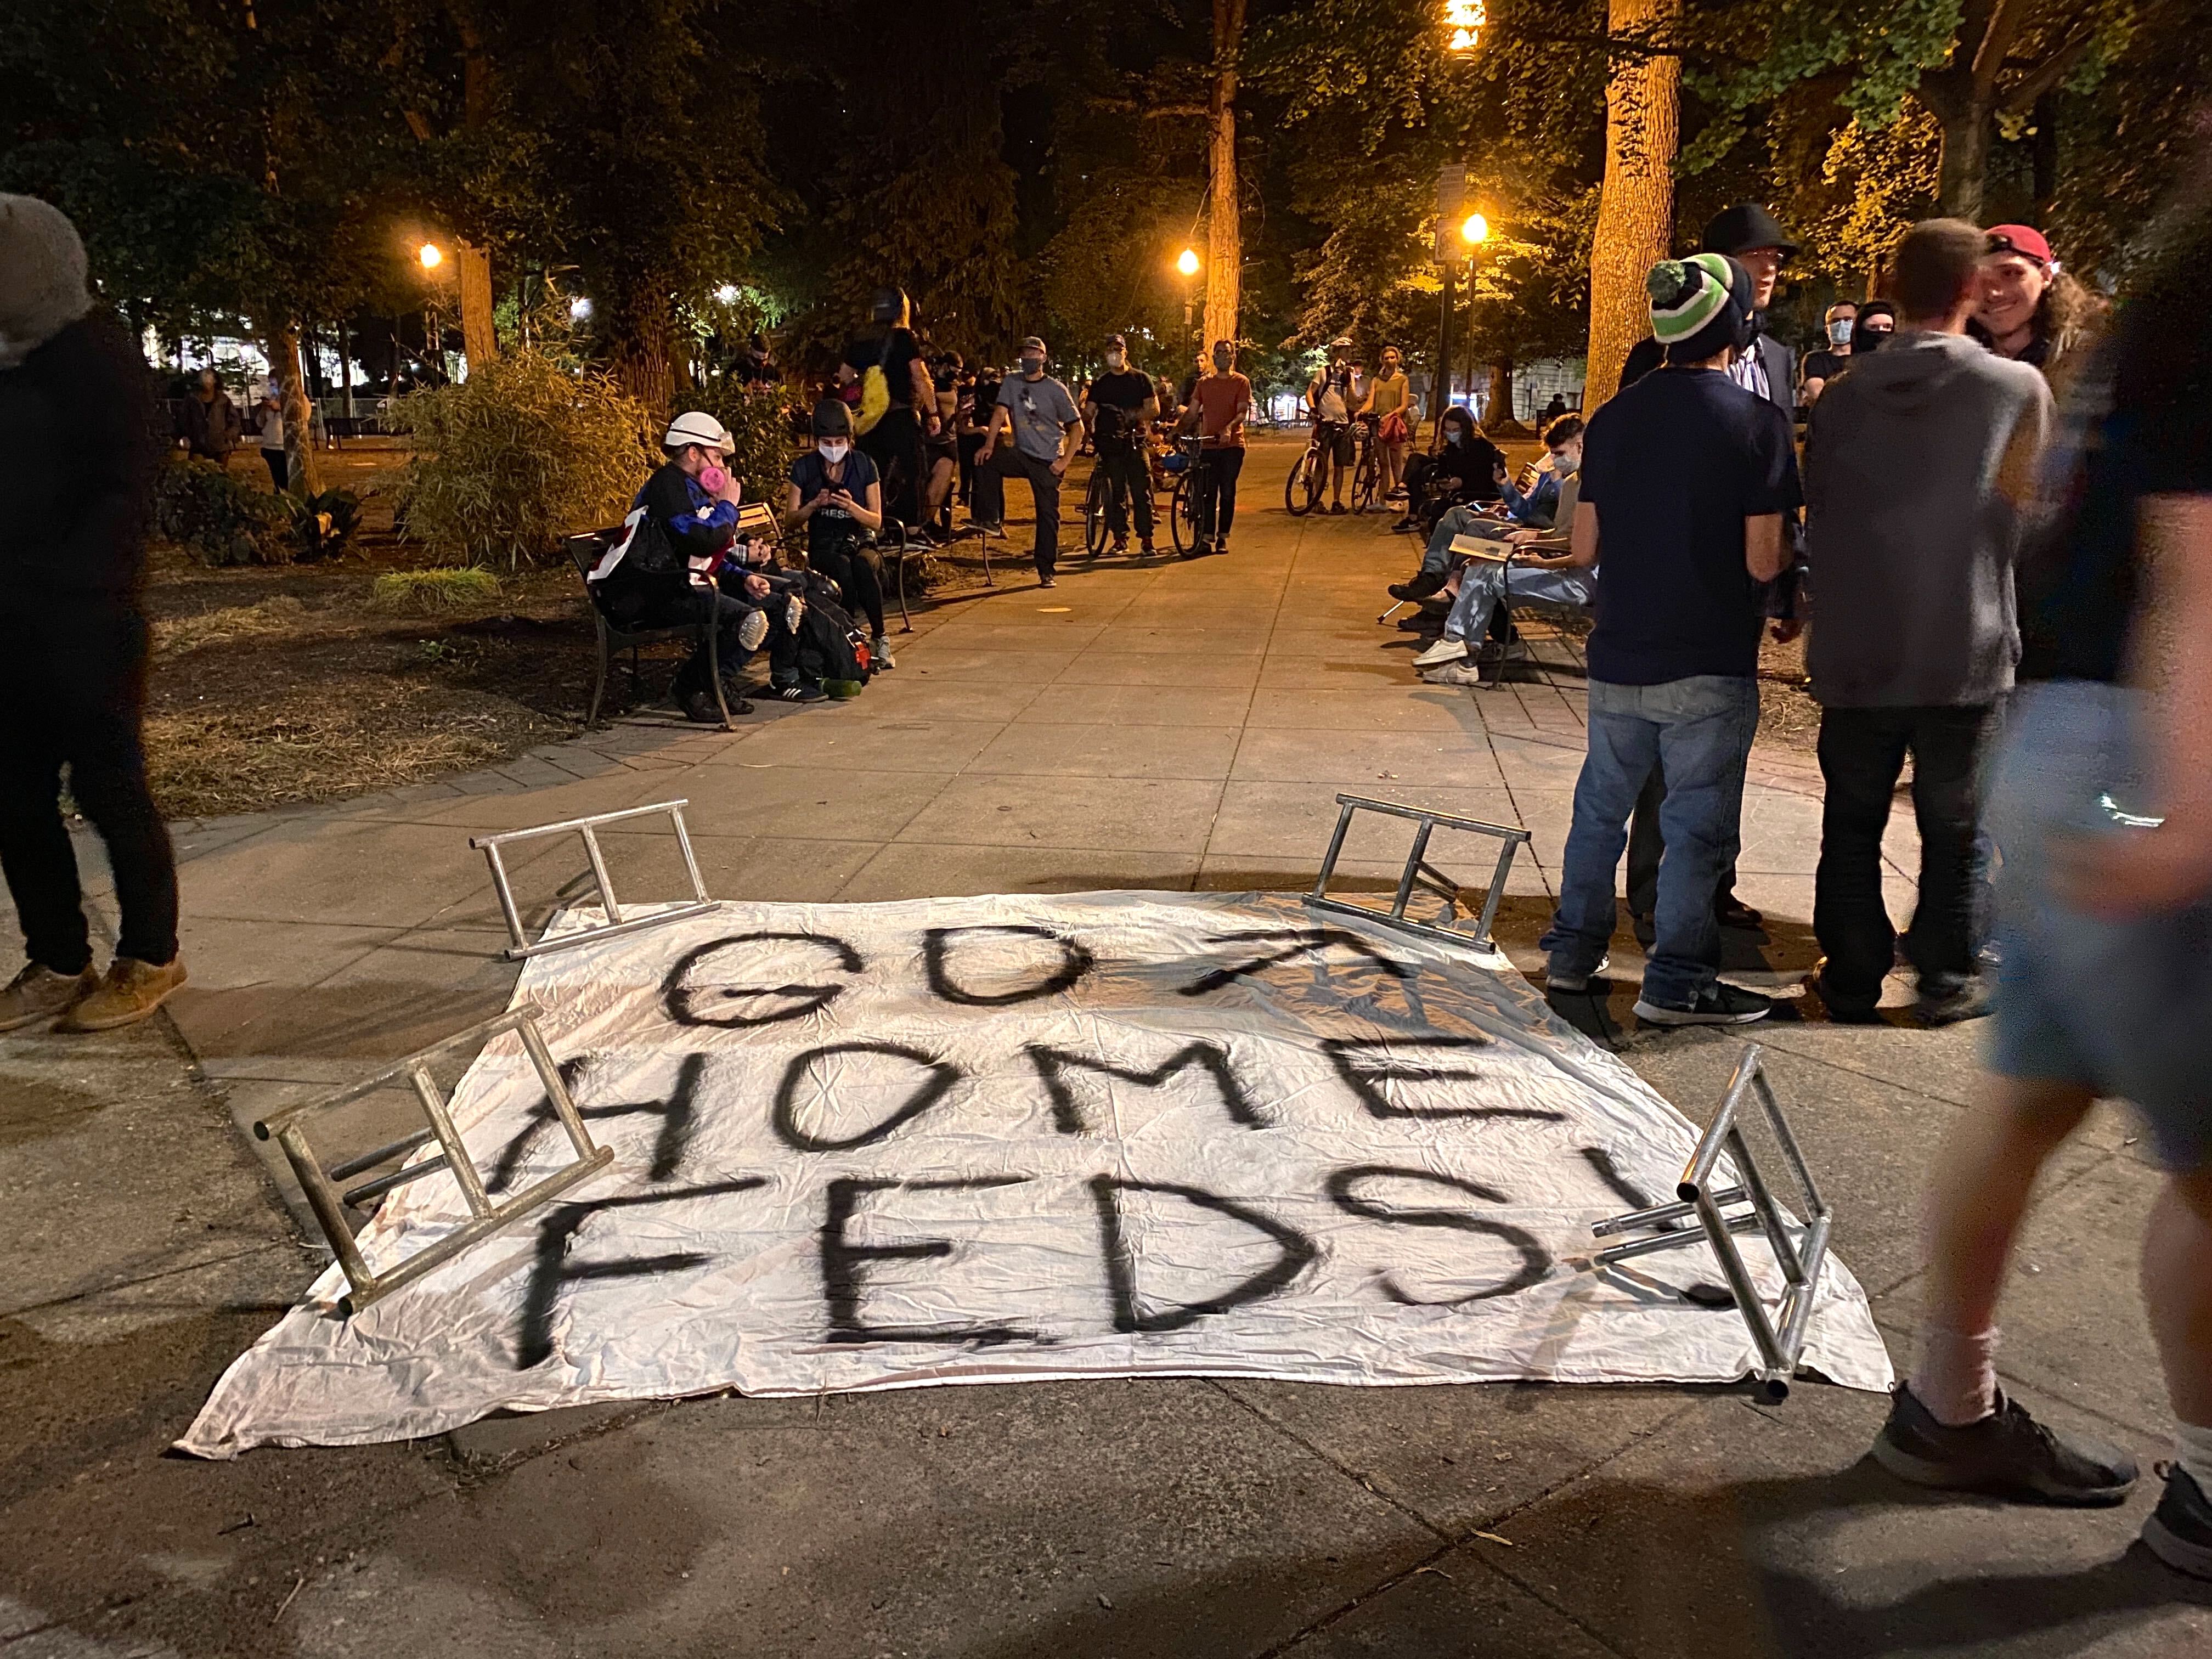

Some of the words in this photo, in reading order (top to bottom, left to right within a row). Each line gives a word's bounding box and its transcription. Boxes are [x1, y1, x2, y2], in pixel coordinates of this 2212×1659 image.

[817, 507, 853, 519] RESS
[487, 1038, 1566, 1194] HOME
[518, 1147, 1740, 1369] FEDS!
